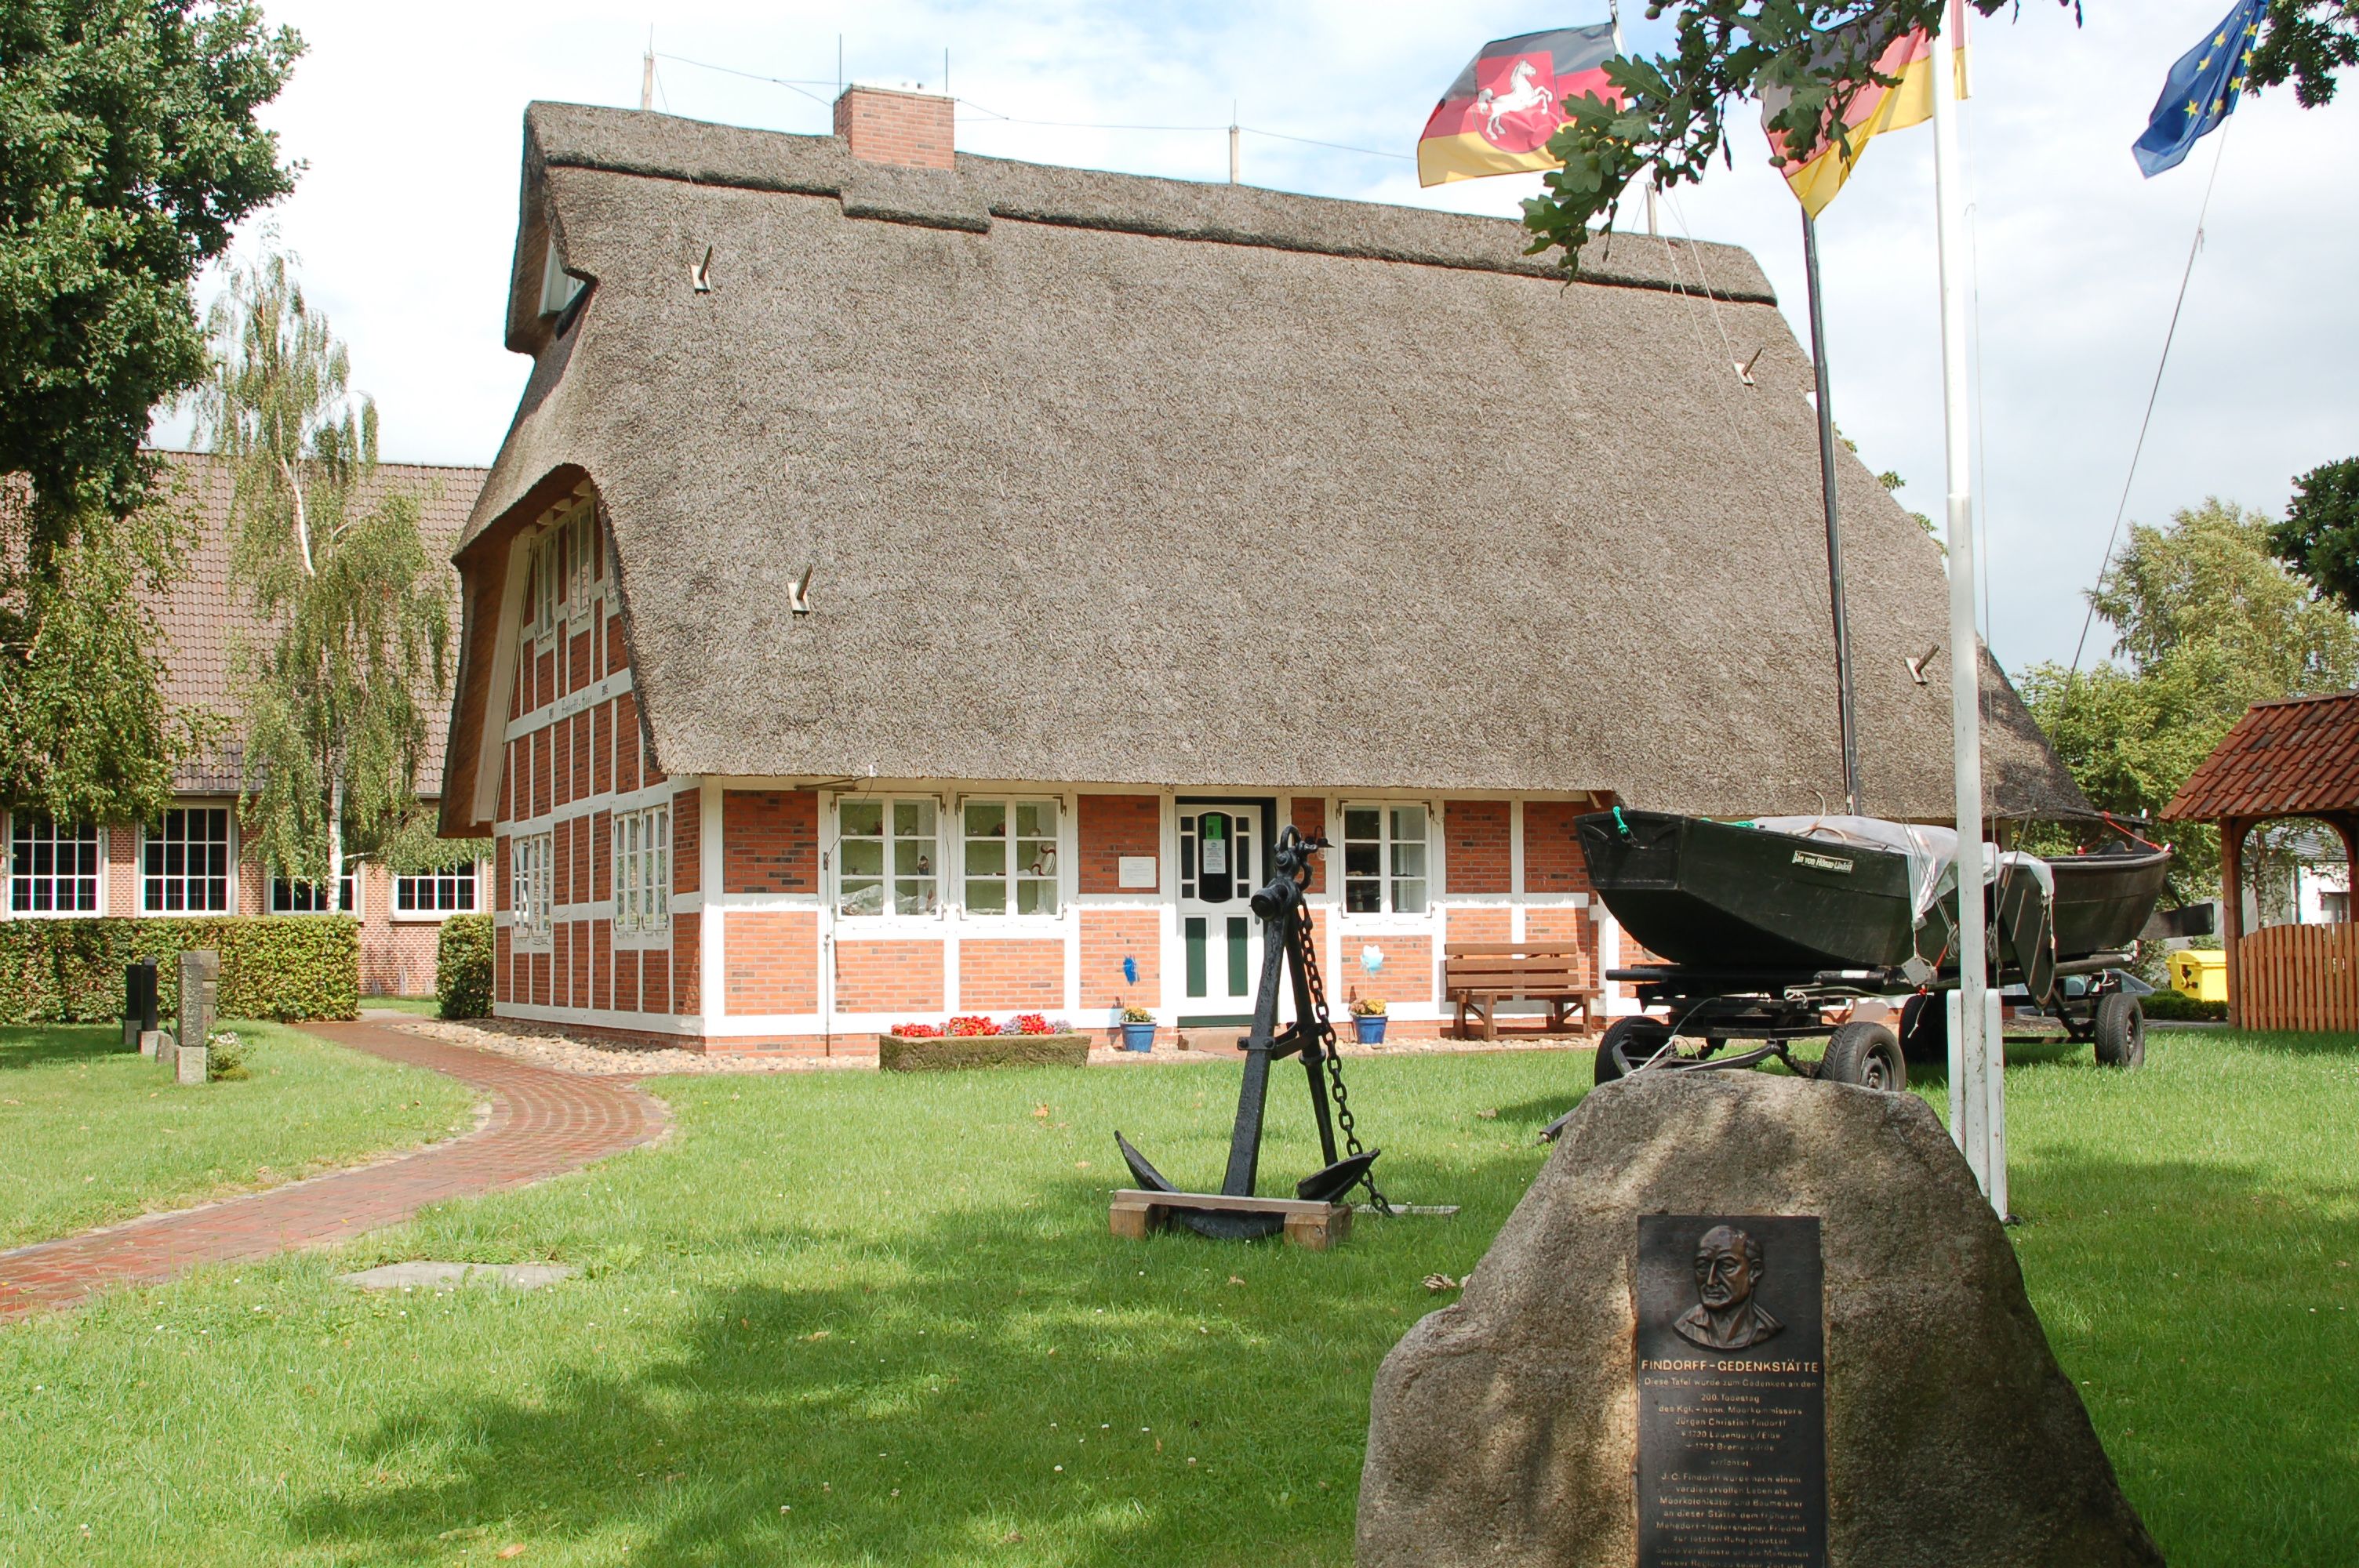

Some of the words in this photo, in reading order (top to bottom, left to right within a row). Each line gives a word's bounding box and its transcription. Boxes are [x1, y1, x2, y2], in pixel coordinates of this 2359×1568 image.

[1671, 1377, 1691, 1386] Tafel
[1695, 1377, 1720, 1386] wurde
[1743, 1378, 1786, 1388] Gedenken
[1721, 1394, 1760, 1403] Todestag
[1675, 1417, 1706, 1426] Jürgen
[1747, 1486, 1772, 1495] Leben
[1753, 1499, 1803, 1508] Baumeister
[1677, 1509, 1704, 1518] dieser
